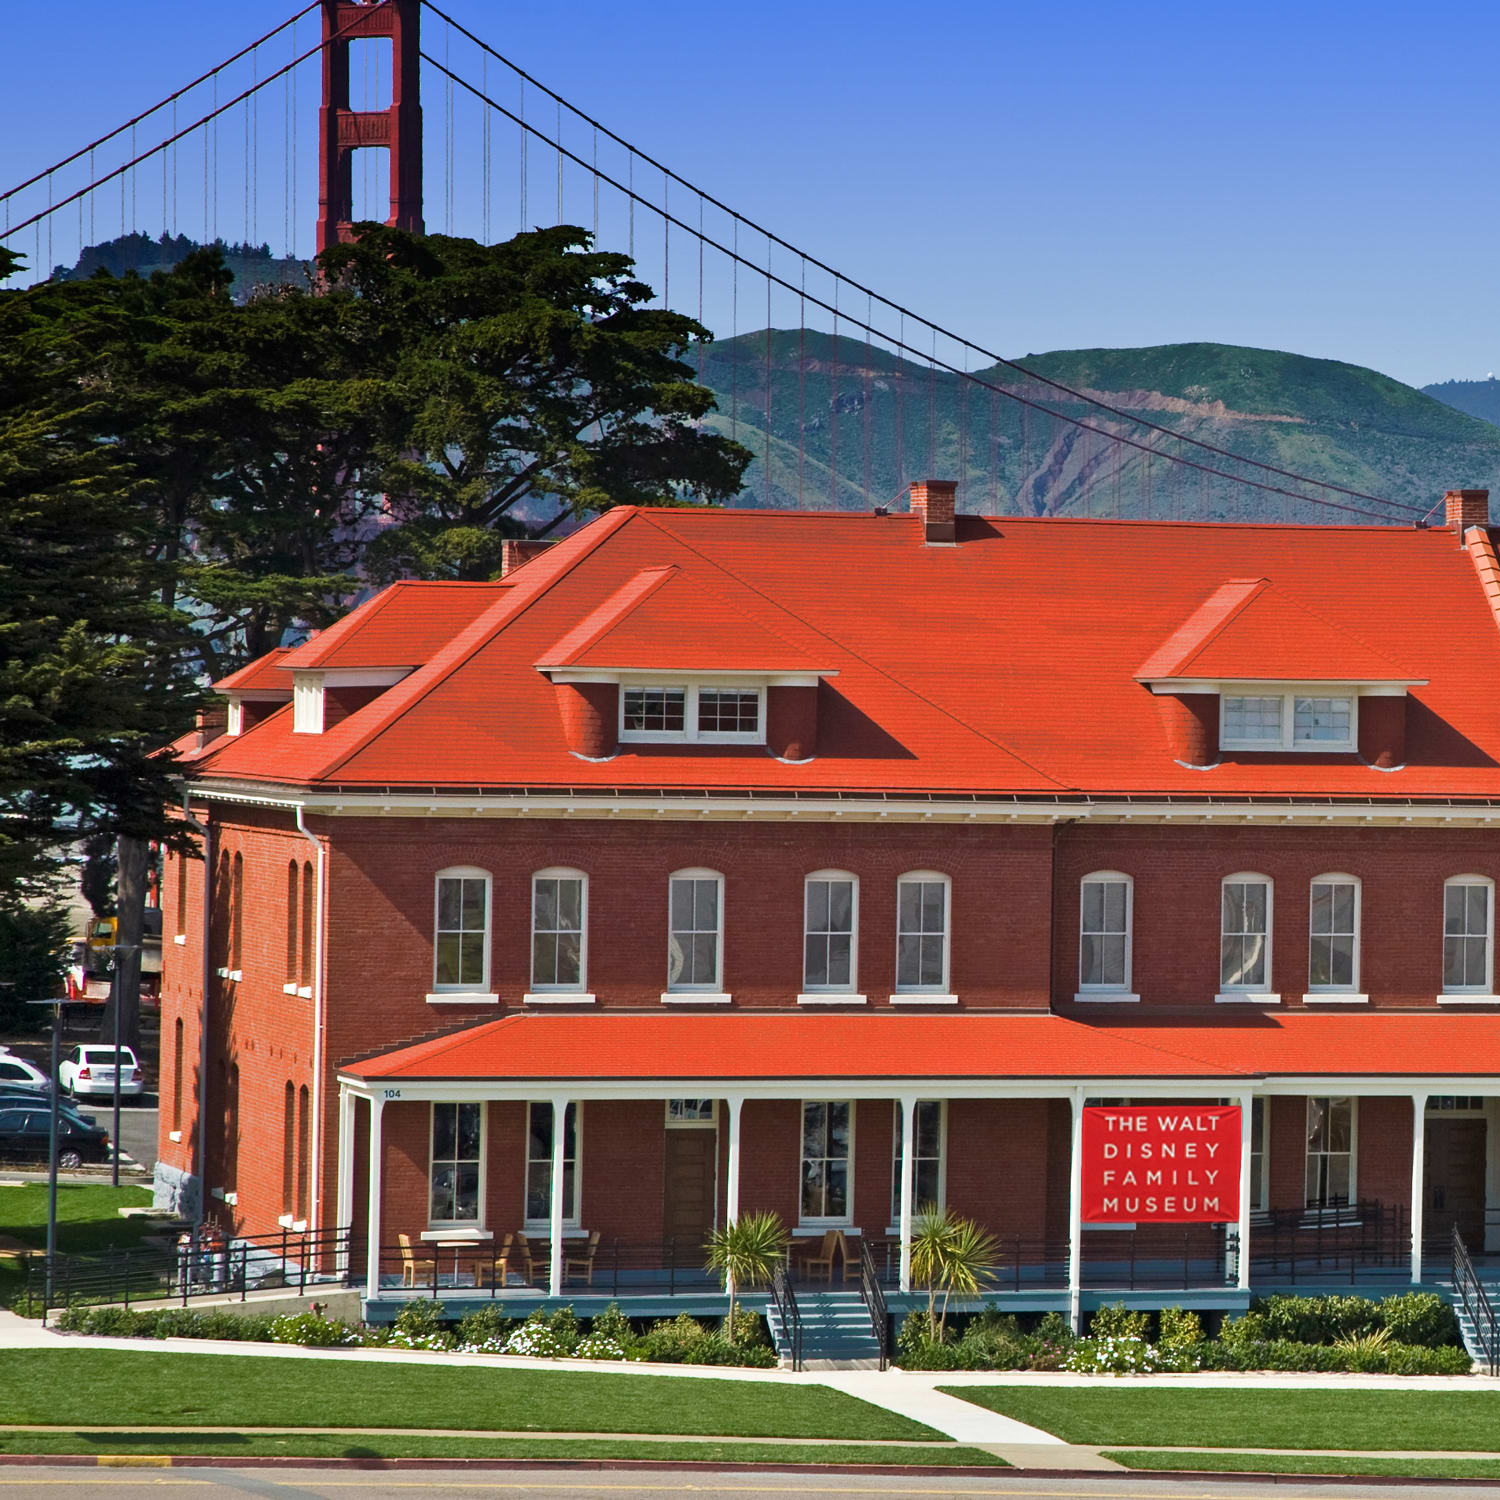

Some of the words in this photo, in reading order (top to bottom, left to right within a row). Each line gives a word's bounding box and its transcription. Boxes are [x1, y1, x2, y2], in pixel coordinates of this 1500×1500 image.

[384, 1090, 401, 1098] 104
[1105, 1116, 1148, 1132] THE
[1158, 1116, 1220, 1132] WALT
[1104, 1143, 1219, 1159] DISNEY
[1104, 1170, 1219, 1185] FAMILY
[1104, 1197, 1219, 1213] MUSEUM
